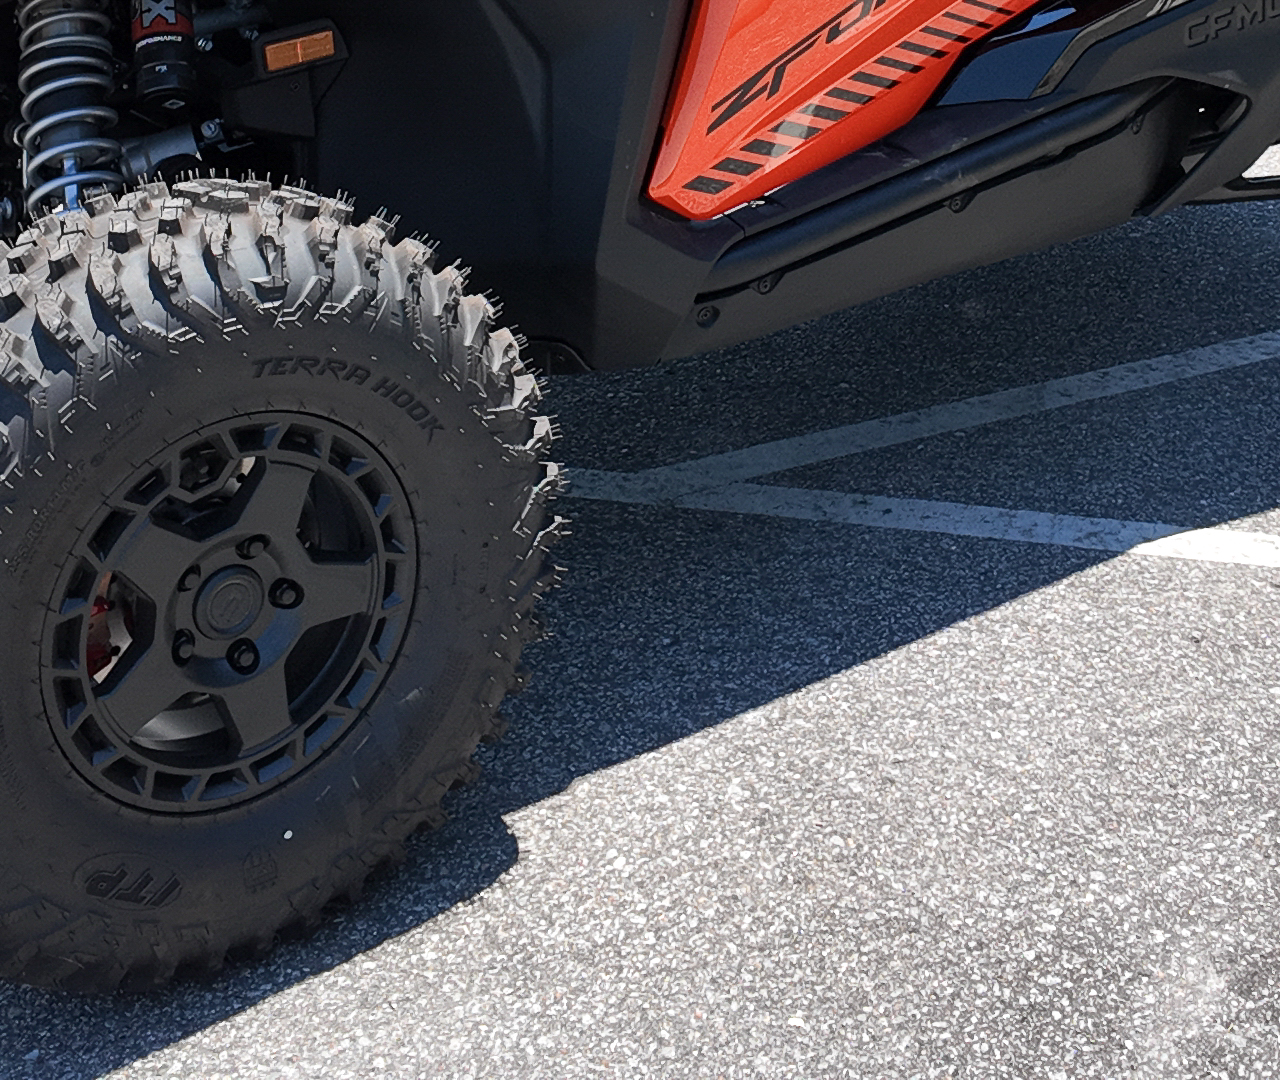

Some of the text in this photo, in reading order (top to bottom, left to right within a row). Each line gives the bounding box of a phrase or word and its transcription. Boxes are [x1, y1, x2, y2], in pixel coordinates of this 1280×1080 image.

[251, 355, 445, 447] TERRA HOOK
[84, 862, 182, 908] ITP
